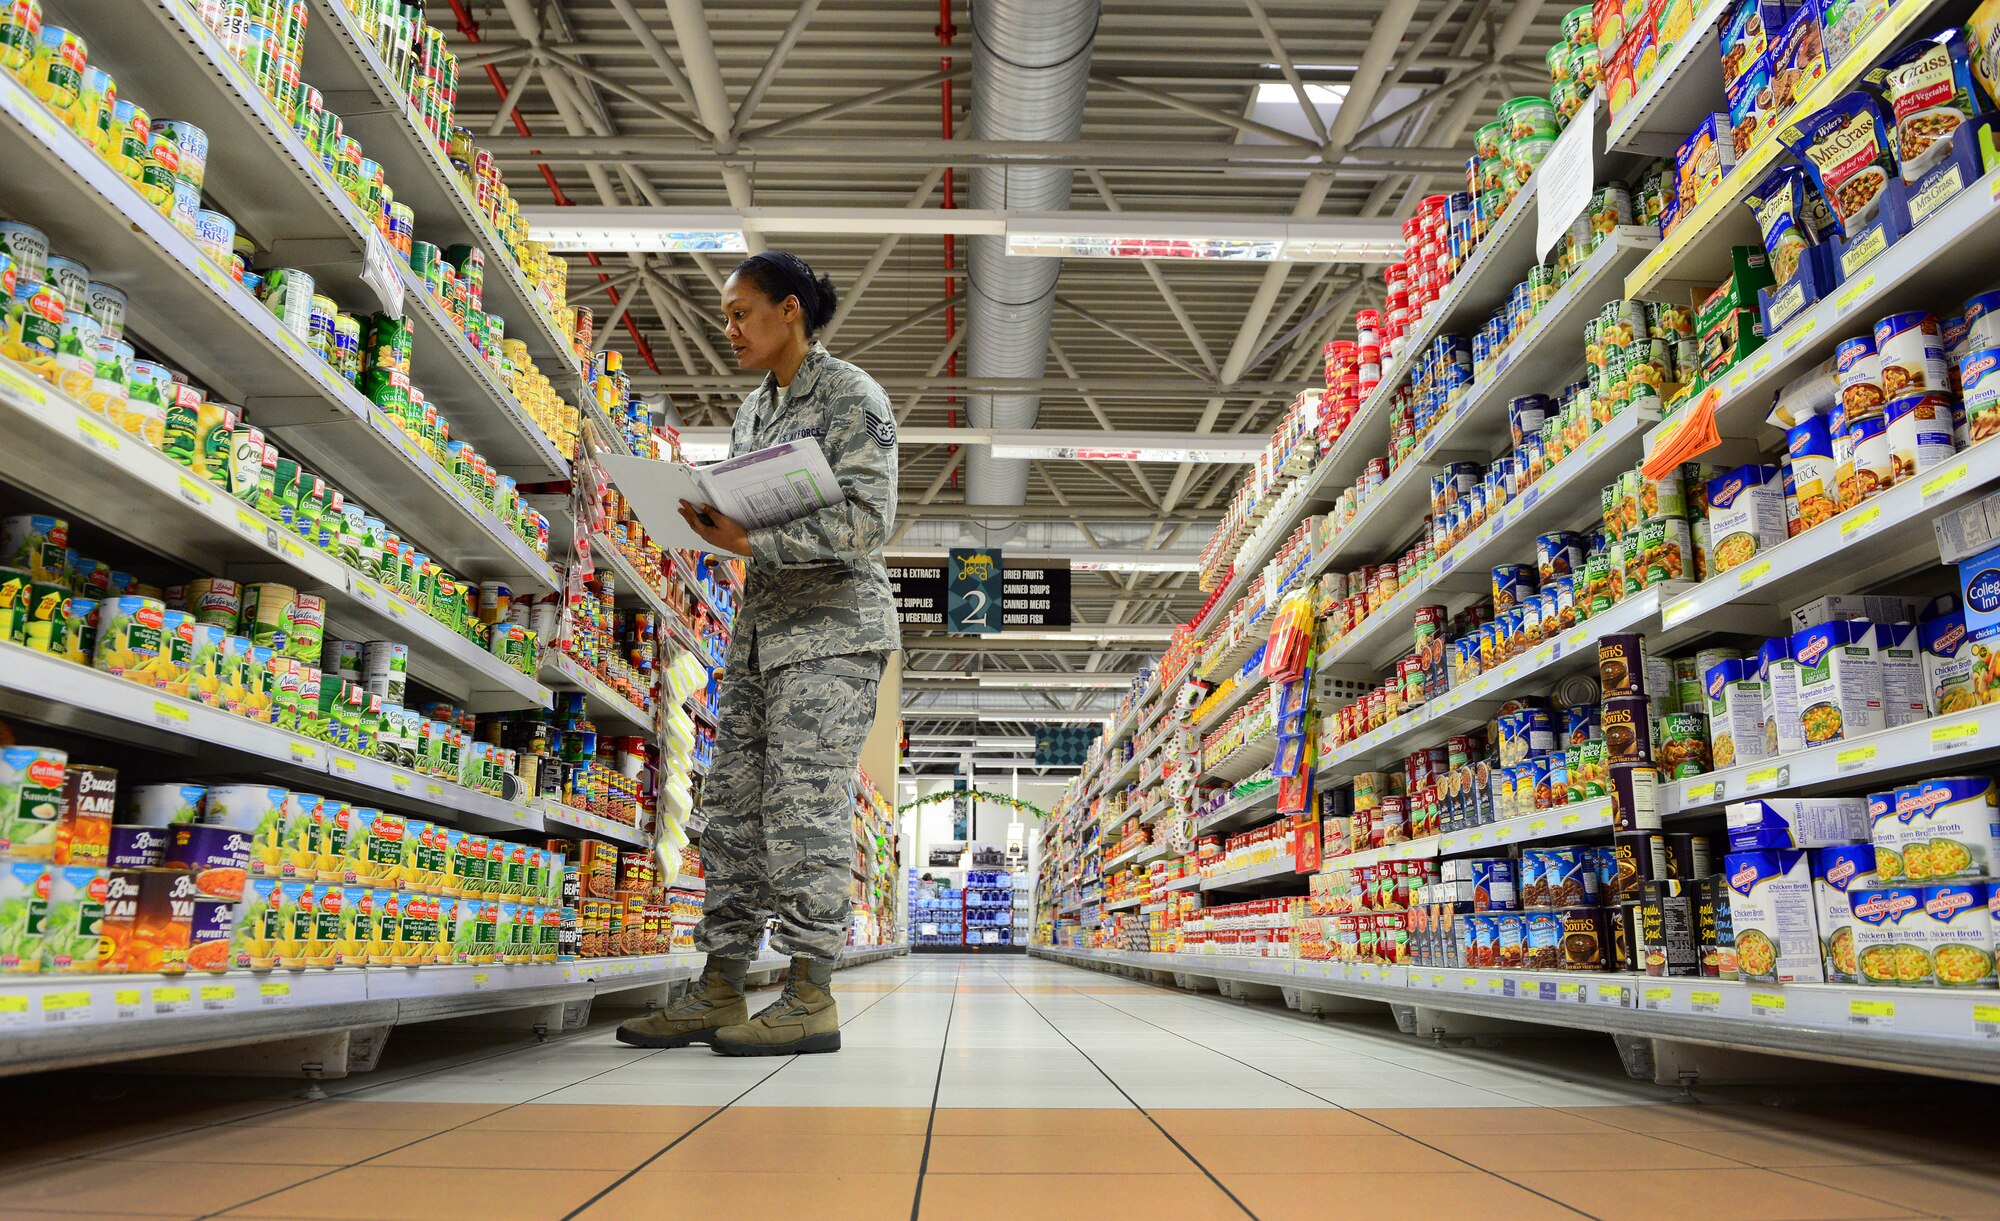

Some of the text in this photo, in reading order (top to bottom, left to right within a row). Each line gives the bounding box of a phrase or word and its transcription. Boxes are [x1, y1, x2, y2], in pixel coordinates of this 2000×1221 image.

[1898, 55, 1949, 86] Grass
[1916, 84, 1950, 102] Vegetable
[1817, 115, 1843, 137] Wyler's
[1811, 139, 1841, 165] Mrs.
[1838, 117, 1874, 151] Grass
[12, 232, 45, 252] Green
[13, 241, 44, 259] Giant
[59, 268, 87, 288] Green
[92, 292, 122, 310] Green
[92, 299, 121, 317] Giant
[1848, 372, 1867, 384] Broth
[1974, 388, 1997, 402] Broth
[1714, 481, 1741, 504] SWANSON
[1714, 512, 1748, 532] Chicken Broth
[902, 568, 908, 579] &
[909, 568, 941, 579] EXTRACTS
[1003, 570, 1044, 580] DRIED FRUITS
[1003, 584, 1050, 595] CANNED SOUPS
[200, 594, 239, 609] Naturals
[904, 598, 933, 608] SUPPLIES
[961, 590, 987, 627] 2
[1003, 599, 1051, 610] CANNED MEATS
[1982, 596, 1999, 610] Inn
[905, 612, 943, 623] VEGETABLES
[1003, 613, 1044, 624] CANNED FISH
[1935, 625, 1964, 650] SWANSON
[1976, 627, 1996, 641] chicken
[1798, 636, 1828, 661] SWANSON
[1935, 659, 1973, 677] Chicken Broth
[1805, 672, 1828, 684] ORGANIC
[1674, 715, 1702, 726] Healthy
[1669, 723, 1702, 734] Choice
[1937, 823, 1961, 832] Broth
[115, 855, 146, 865] SWEET
[207, 856, 236, 867] SWEET
[1733, 868, 1757, 886] SWANSON
[1828, 863, 1855, 882] SWANSON
[1928, 895, 1968, 911] SWANSON
[1734, 909, 1765, 918] Chicken Broth
[1564, 918, 1594, 932] SOUPS
[196, 930, 222, 939] SWEET
[1858, 932, 1886, 940] Chicken
[1956, 930, 1982, 938] Broth
